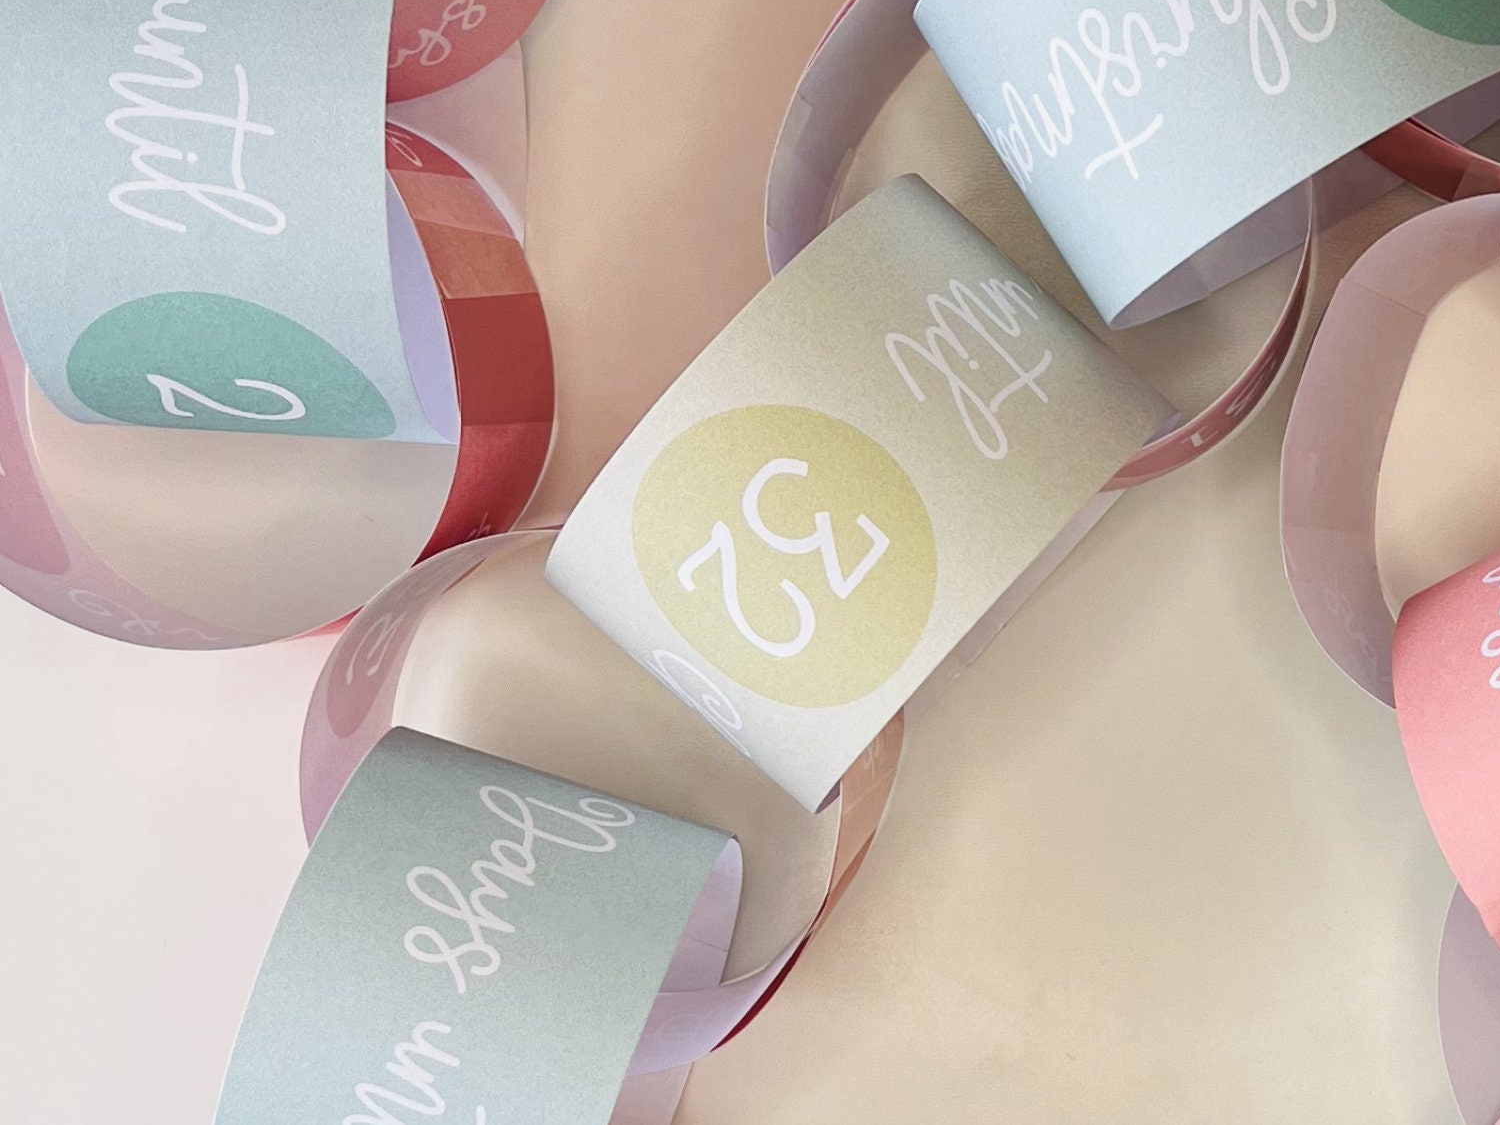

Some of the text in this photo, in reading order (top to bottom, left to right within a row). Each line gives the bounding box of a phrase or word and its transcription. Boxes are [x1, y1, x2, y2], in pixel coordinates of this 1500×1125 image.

[885, 275, 1052, 460] until
[677, 458, 890, 658] 32
[405, 785, 636, 994] Days
